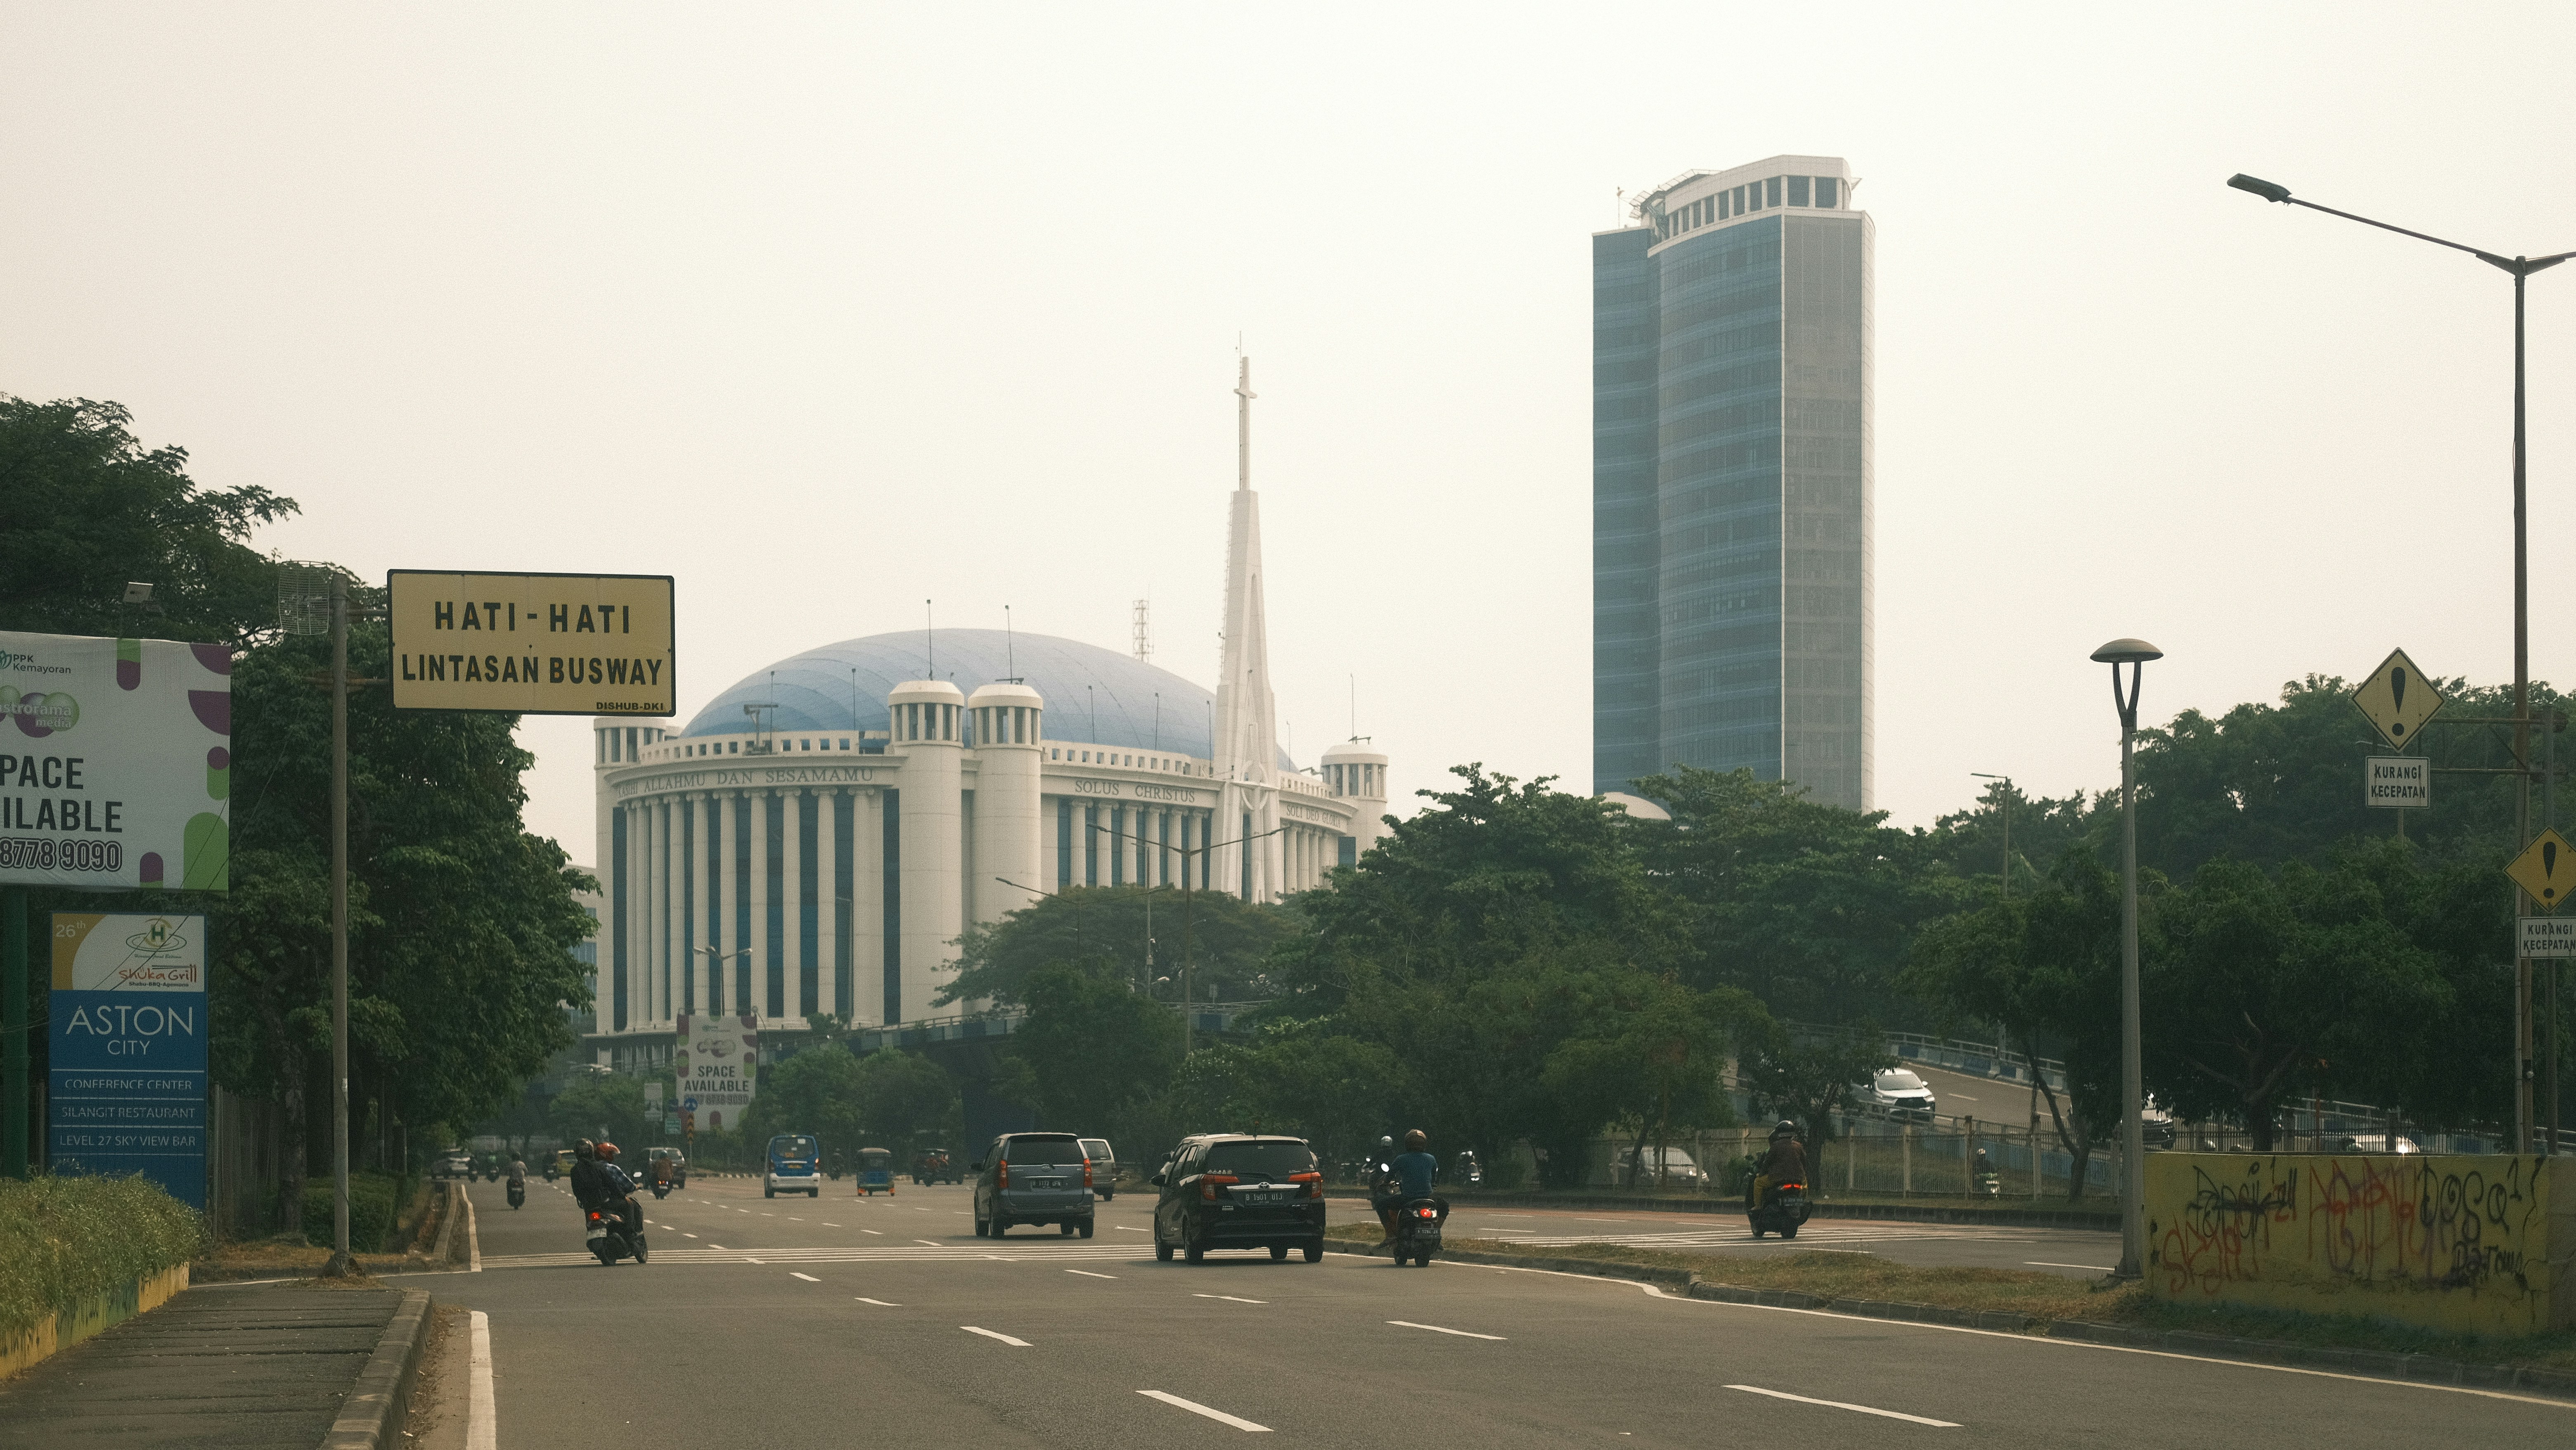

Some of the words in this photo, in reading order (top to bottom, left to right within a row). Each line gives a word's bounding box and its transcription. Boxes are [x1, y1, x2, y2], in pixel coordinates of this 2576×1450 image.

[13, 654, 34, 663] PPK
[13, 663, 71, 674] Kemayoran
[402, 654, 539, 682] LINTASAN
[549, 657, 662, 685] BUSWAY
[0, 702, 71, 716] strorama
[596, 702, 663, 710] DISHUB-DKI
[36, 718, 71, 727] media
[2375, 765, 2421, 779] KURANGI
[644, 774, 705, 793] ALLAHMU
[717, 772, 752, 784] DAN
[766, 769, 873, 783] SESAMAMU
[1075, 780, 1119, 796] SOLUS
[1135, 785, 1195, 803] CHRISTUS
[2371, 785, 2425, 798] KECEPATAN
[1286, 806, 1302, 818] SOLI
[1306, 809, 1319, 821] DEO
[1322, 812, 1341, 828] GLORIA
[59, 839, 123, 872] 9090
[2528, 924, 2572, 935] KURANGI
[2524, 940, 2576, 950] KECEPATAN
[168, 964, 197, 983] Grill
[66, 1005, 192, 1036] ASTON
[107, 1040, 150, 1055] CITY
[698, 1065, 736, 1077] SPACE
[65, 1079, 144, 1089] CONFERENCE
[147, 1080, 192, 1090] CENTER
[684, 1080, 749, 1092] AVAILABLE
[62, 1107, 115, 1117] SILANGIT
[118, 1108, 195, 1118] RESTAURANT
[60, 1135, 94, 1145] LEVEL
[98, 1136, 111, 1145] 27
[115, 1136, 136, 1145] SKY
[140, 1136, 168, 1146] VIEW
[173, 1136, 196, 1146] BAR
